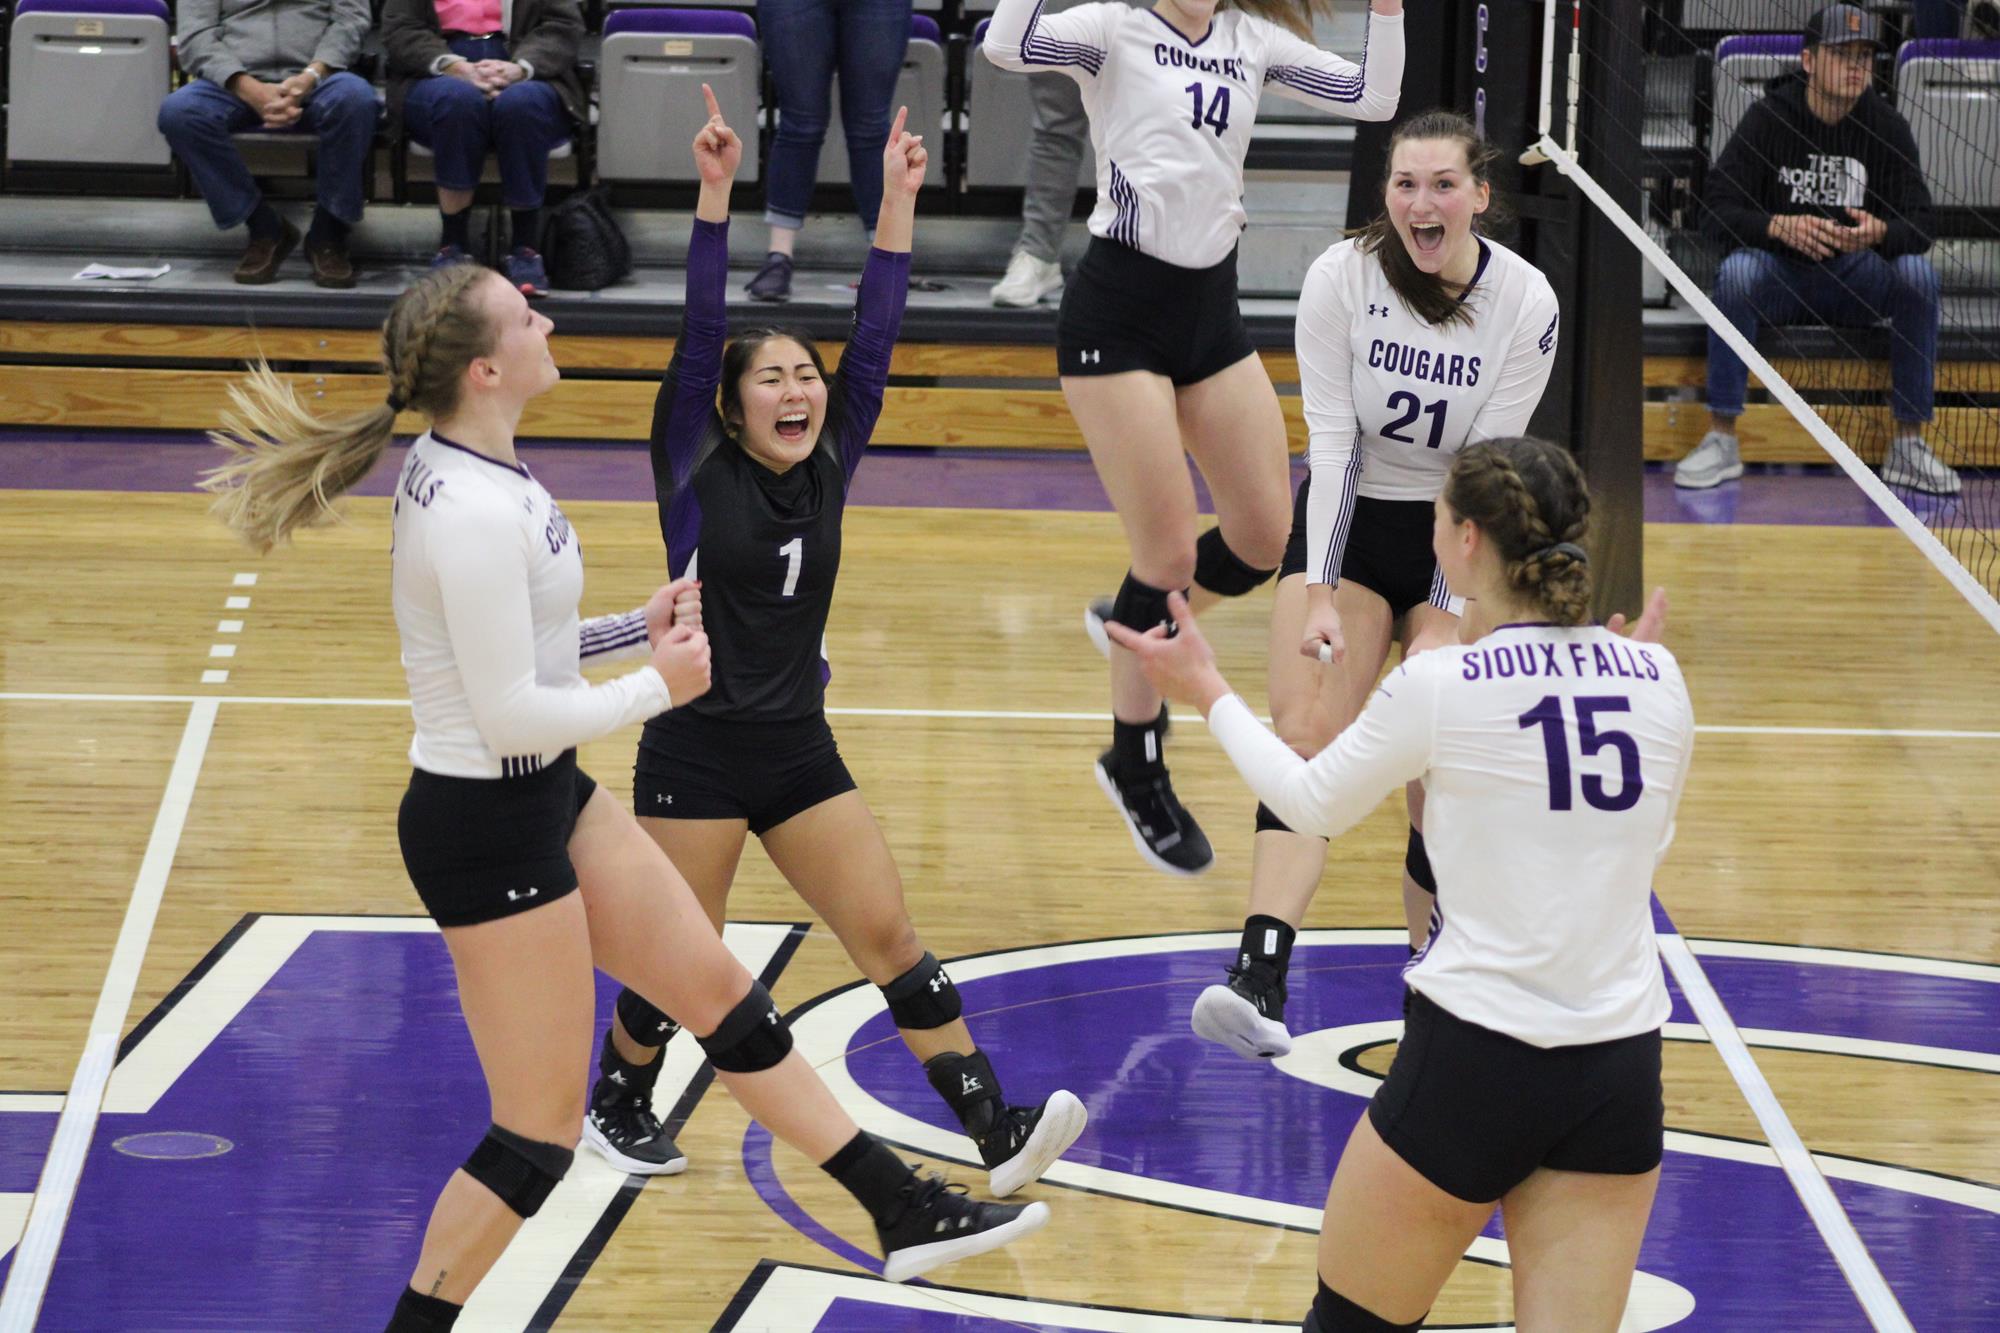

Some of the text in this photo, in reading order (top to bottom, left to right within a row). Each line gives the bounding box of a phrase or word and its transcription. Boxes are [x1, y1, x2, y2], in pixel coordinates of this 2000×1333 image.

[1185, 82, 1230, 137] 14
[1778, 166, 1842, 193] NORTH
[1807, 153, 1843, 173] THE
[1790, 187, 1841, 206] FACE
[1368, 338, 1481, 387] COUGARS
[1379, 390, 1449, 449] 21
[779, 537, 803, 596] 1
[1462, 643, 1660, 681] SIOUX FALLS
[1518, 695, 1644, 812] 15
